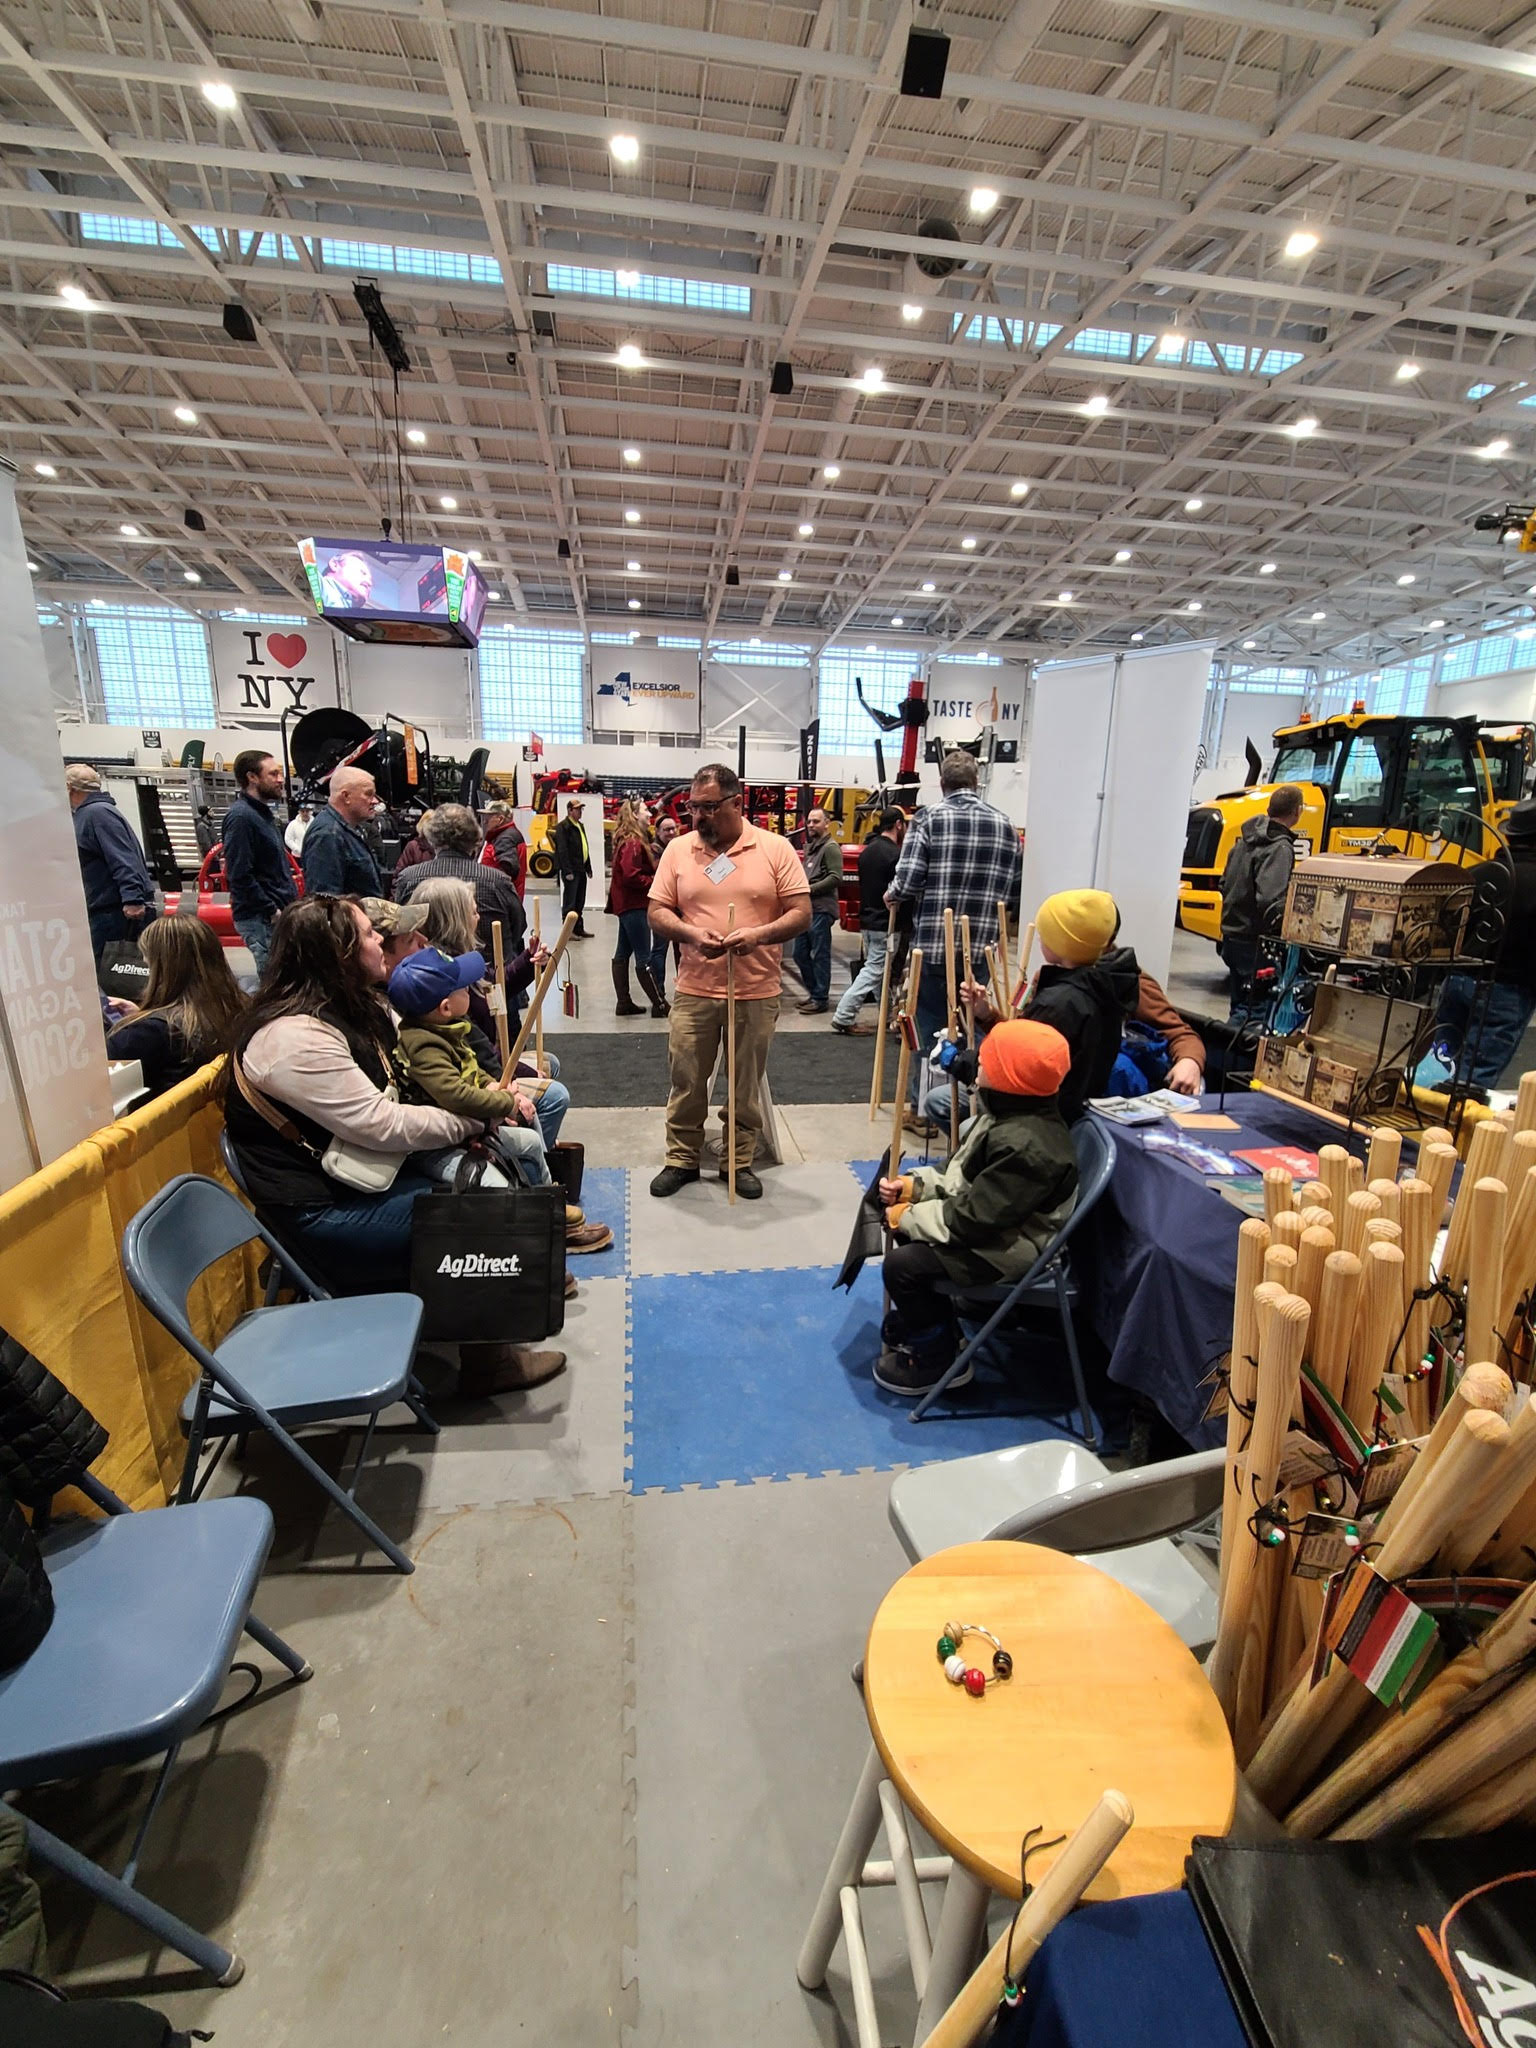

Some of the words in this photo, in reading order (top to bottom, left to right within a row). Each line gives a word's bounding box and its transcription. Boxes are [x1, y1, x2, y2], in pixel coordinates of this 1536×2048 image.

[243, 631, 264, 665] I
[237, 674, 315, 709] NY
[632, 682, 680, 691] EXCELSIOR
[632, 690, 657, 698] EVER
[658, 691, 695, 699] UPWARD
[933, 700, 972, 717] TASTE
[1001, 703, 1020, 720] NY
